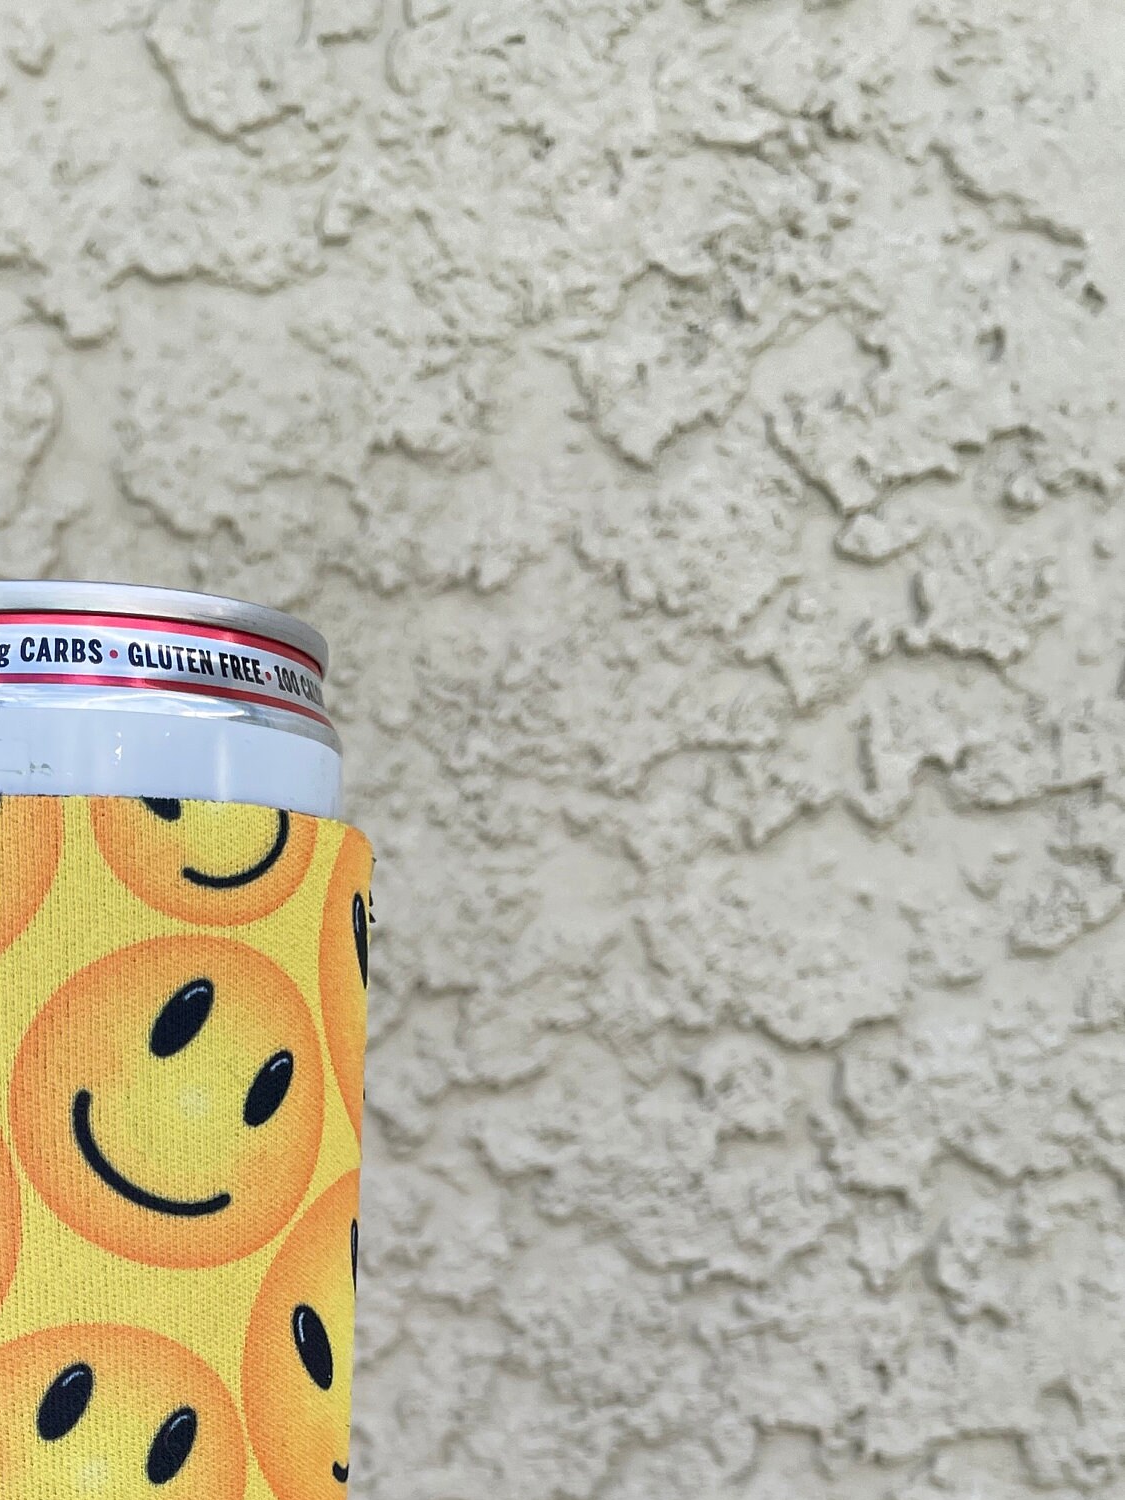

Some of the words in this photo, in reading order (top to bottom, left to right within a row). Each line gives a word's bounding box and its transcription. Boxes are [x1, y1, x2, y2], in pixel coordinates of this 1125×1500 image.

[20, 636, 103, 665] CARBS
[128, 641, 214, 676] GLUTEN
[218, 652, 265, 685] FREE
[274, 665, 301, 696] 100
